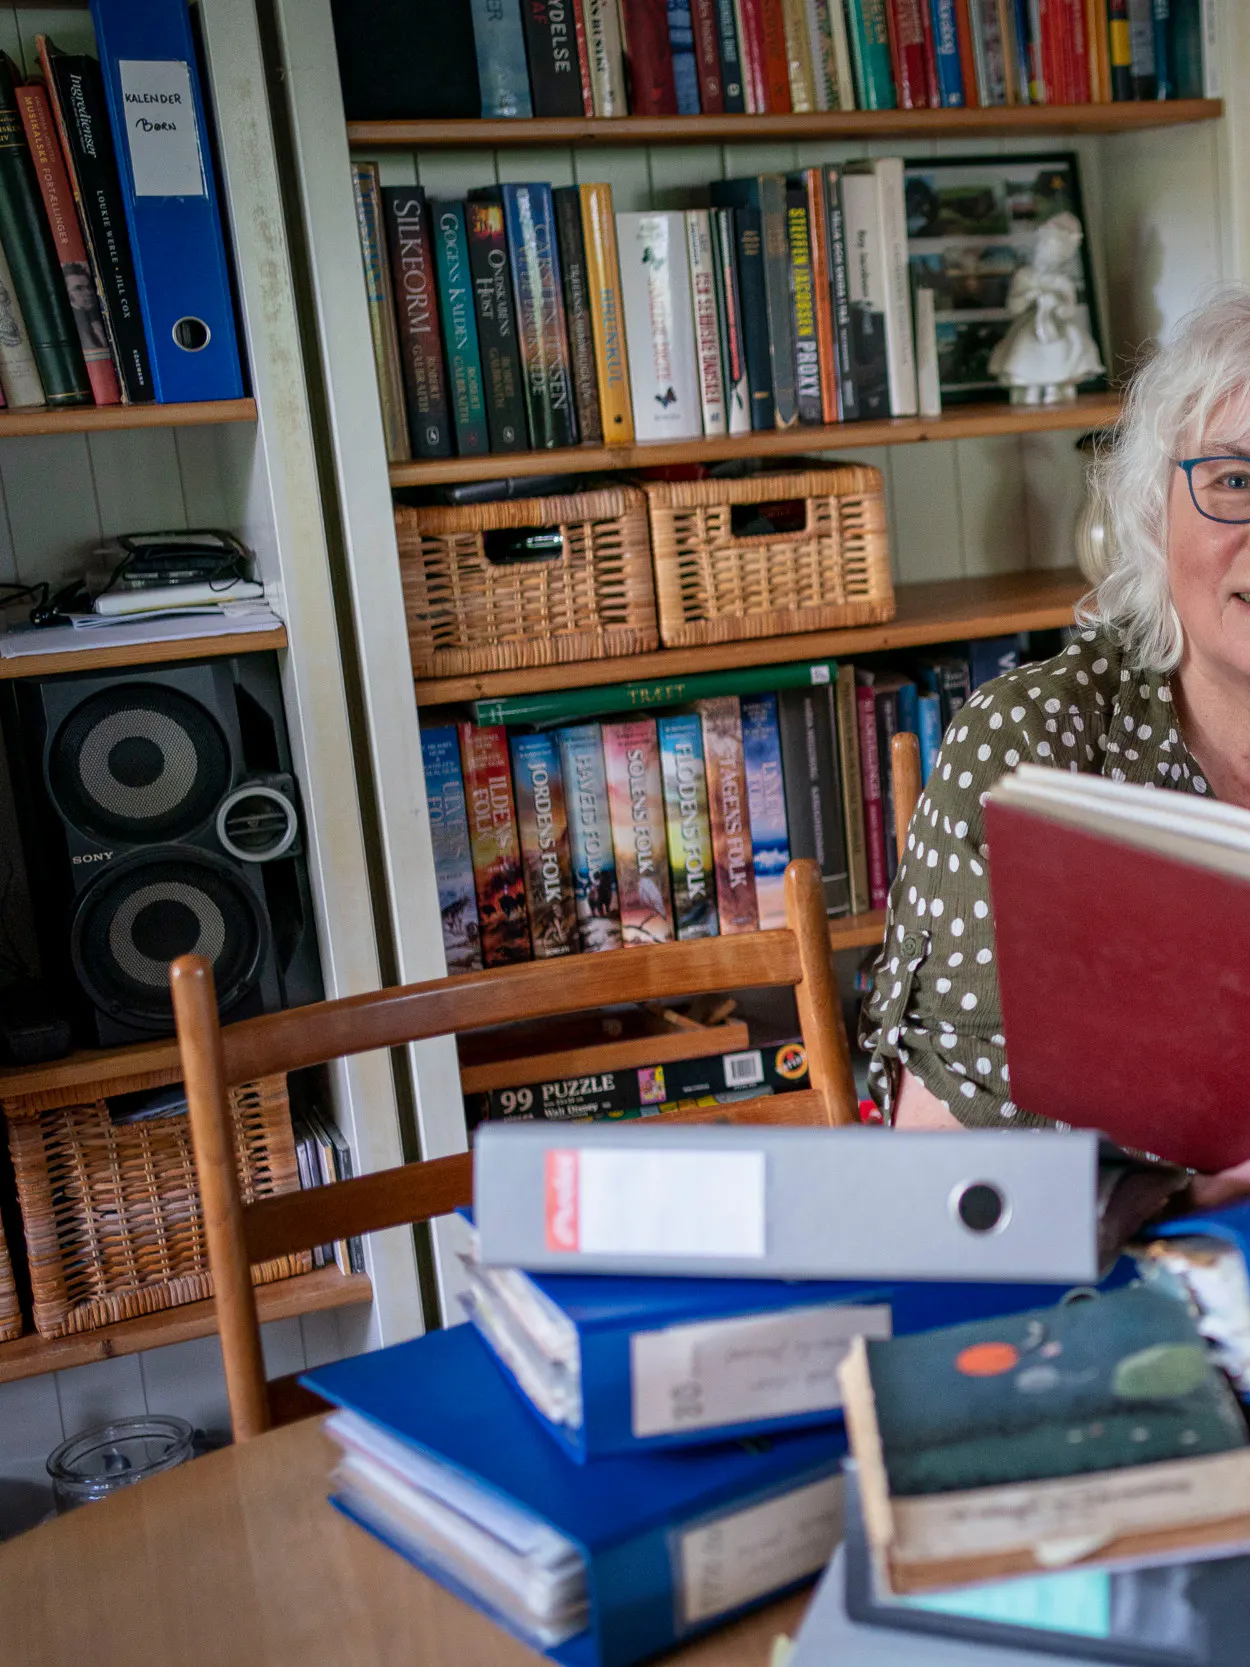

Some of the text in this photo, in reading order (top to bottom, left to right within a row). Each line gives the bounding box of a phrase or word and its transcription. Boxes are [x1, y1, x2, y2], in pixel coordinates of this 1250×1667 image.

[70, 73, 98, 158] Ingredienser
[125, 93, 182, 105] KALENDER
[24, 96, 68, 244] MUSIKALSKE FORTÆLLINGER
[96, 190, 132, 319] LOUKIE WERLE JILL COX
[393, 199, 432, 334] SILKEORM
[533, 222, 568, 411] CARSTEN JENSEN
[600, 288, 623, 388] BRUNKUL
[789, 207, 820, 397] STEFFEN JACOBSEN PROXY
[472, 784, 495, 840] FOLK
[488, 766, 513, 849] ILDENS
[529, 762, 555, 849] JORDENS
[627, 748, 649, 821] SOLENS
[674, 742, 700, 841] FLODENS
[72, 851, 114, 865] SONY
[540, 850, 563, 903] FOLK
[633, 825, 655, 874] FOLK
[683, 843, 706, 900] FOLK
[727, 836, 747, 888] FOLK
[499, 1087, 535, 1114] 99
[540, 1073, 616, 1101] PUZZLE
[543, 1106, 565, 1119] Walt
[566, 1100, 599, 1116] Disney
